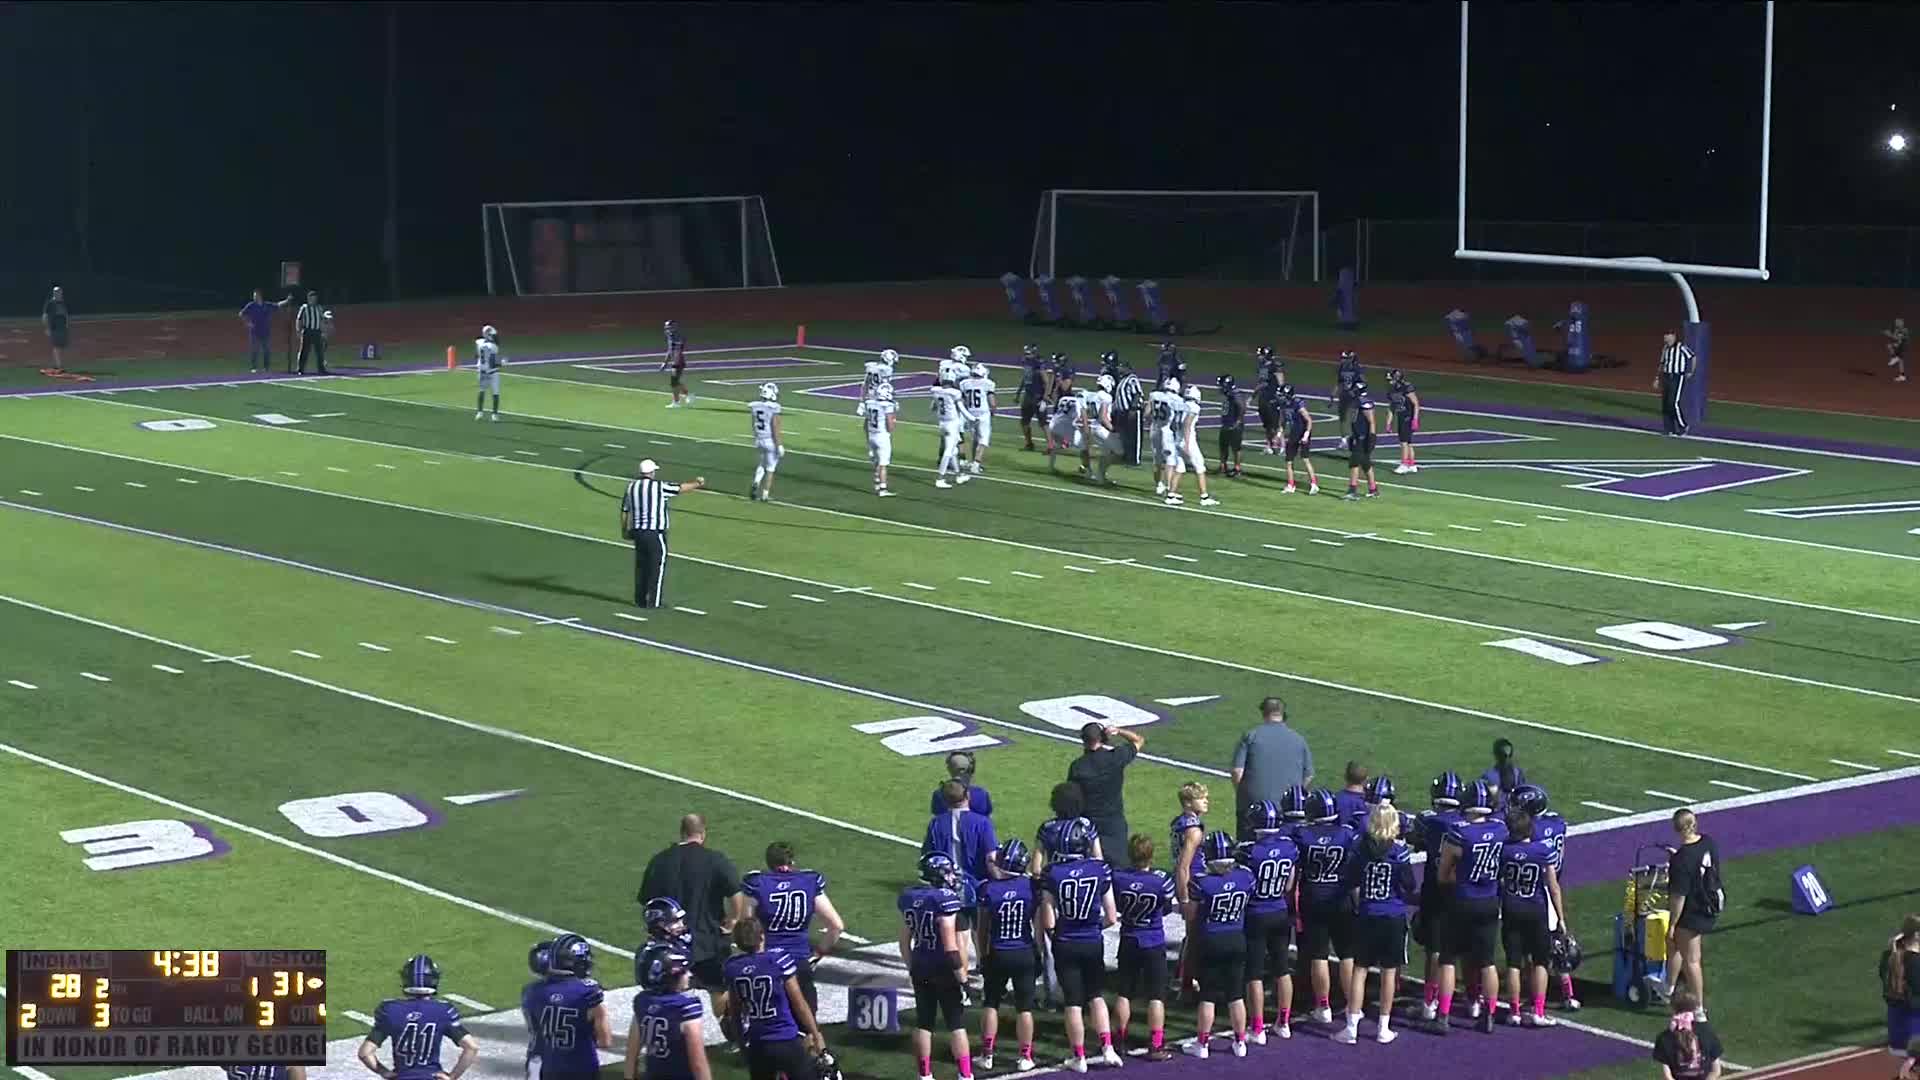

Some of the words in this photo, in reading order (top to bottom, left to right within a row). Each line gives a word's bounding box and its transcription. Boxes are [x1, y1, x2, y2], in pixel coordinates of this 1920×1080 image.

[756, 410, 765, 430] 5
[850, 694, 1161, 757] 20
[59, 791, 429, 871] 30
[1307, 844, 1344, 883] 52
[1470, 841, 1503, 882] 74
[1058, 876, 1099, 921] 87
[1801, 871, 1828, 908] 20
[768, 889, 807, 932] 70
[998, 899, 1025, 940] 11
[856, 993, 889, 1031] 30
[395, 1022, 437, 1067] 41
